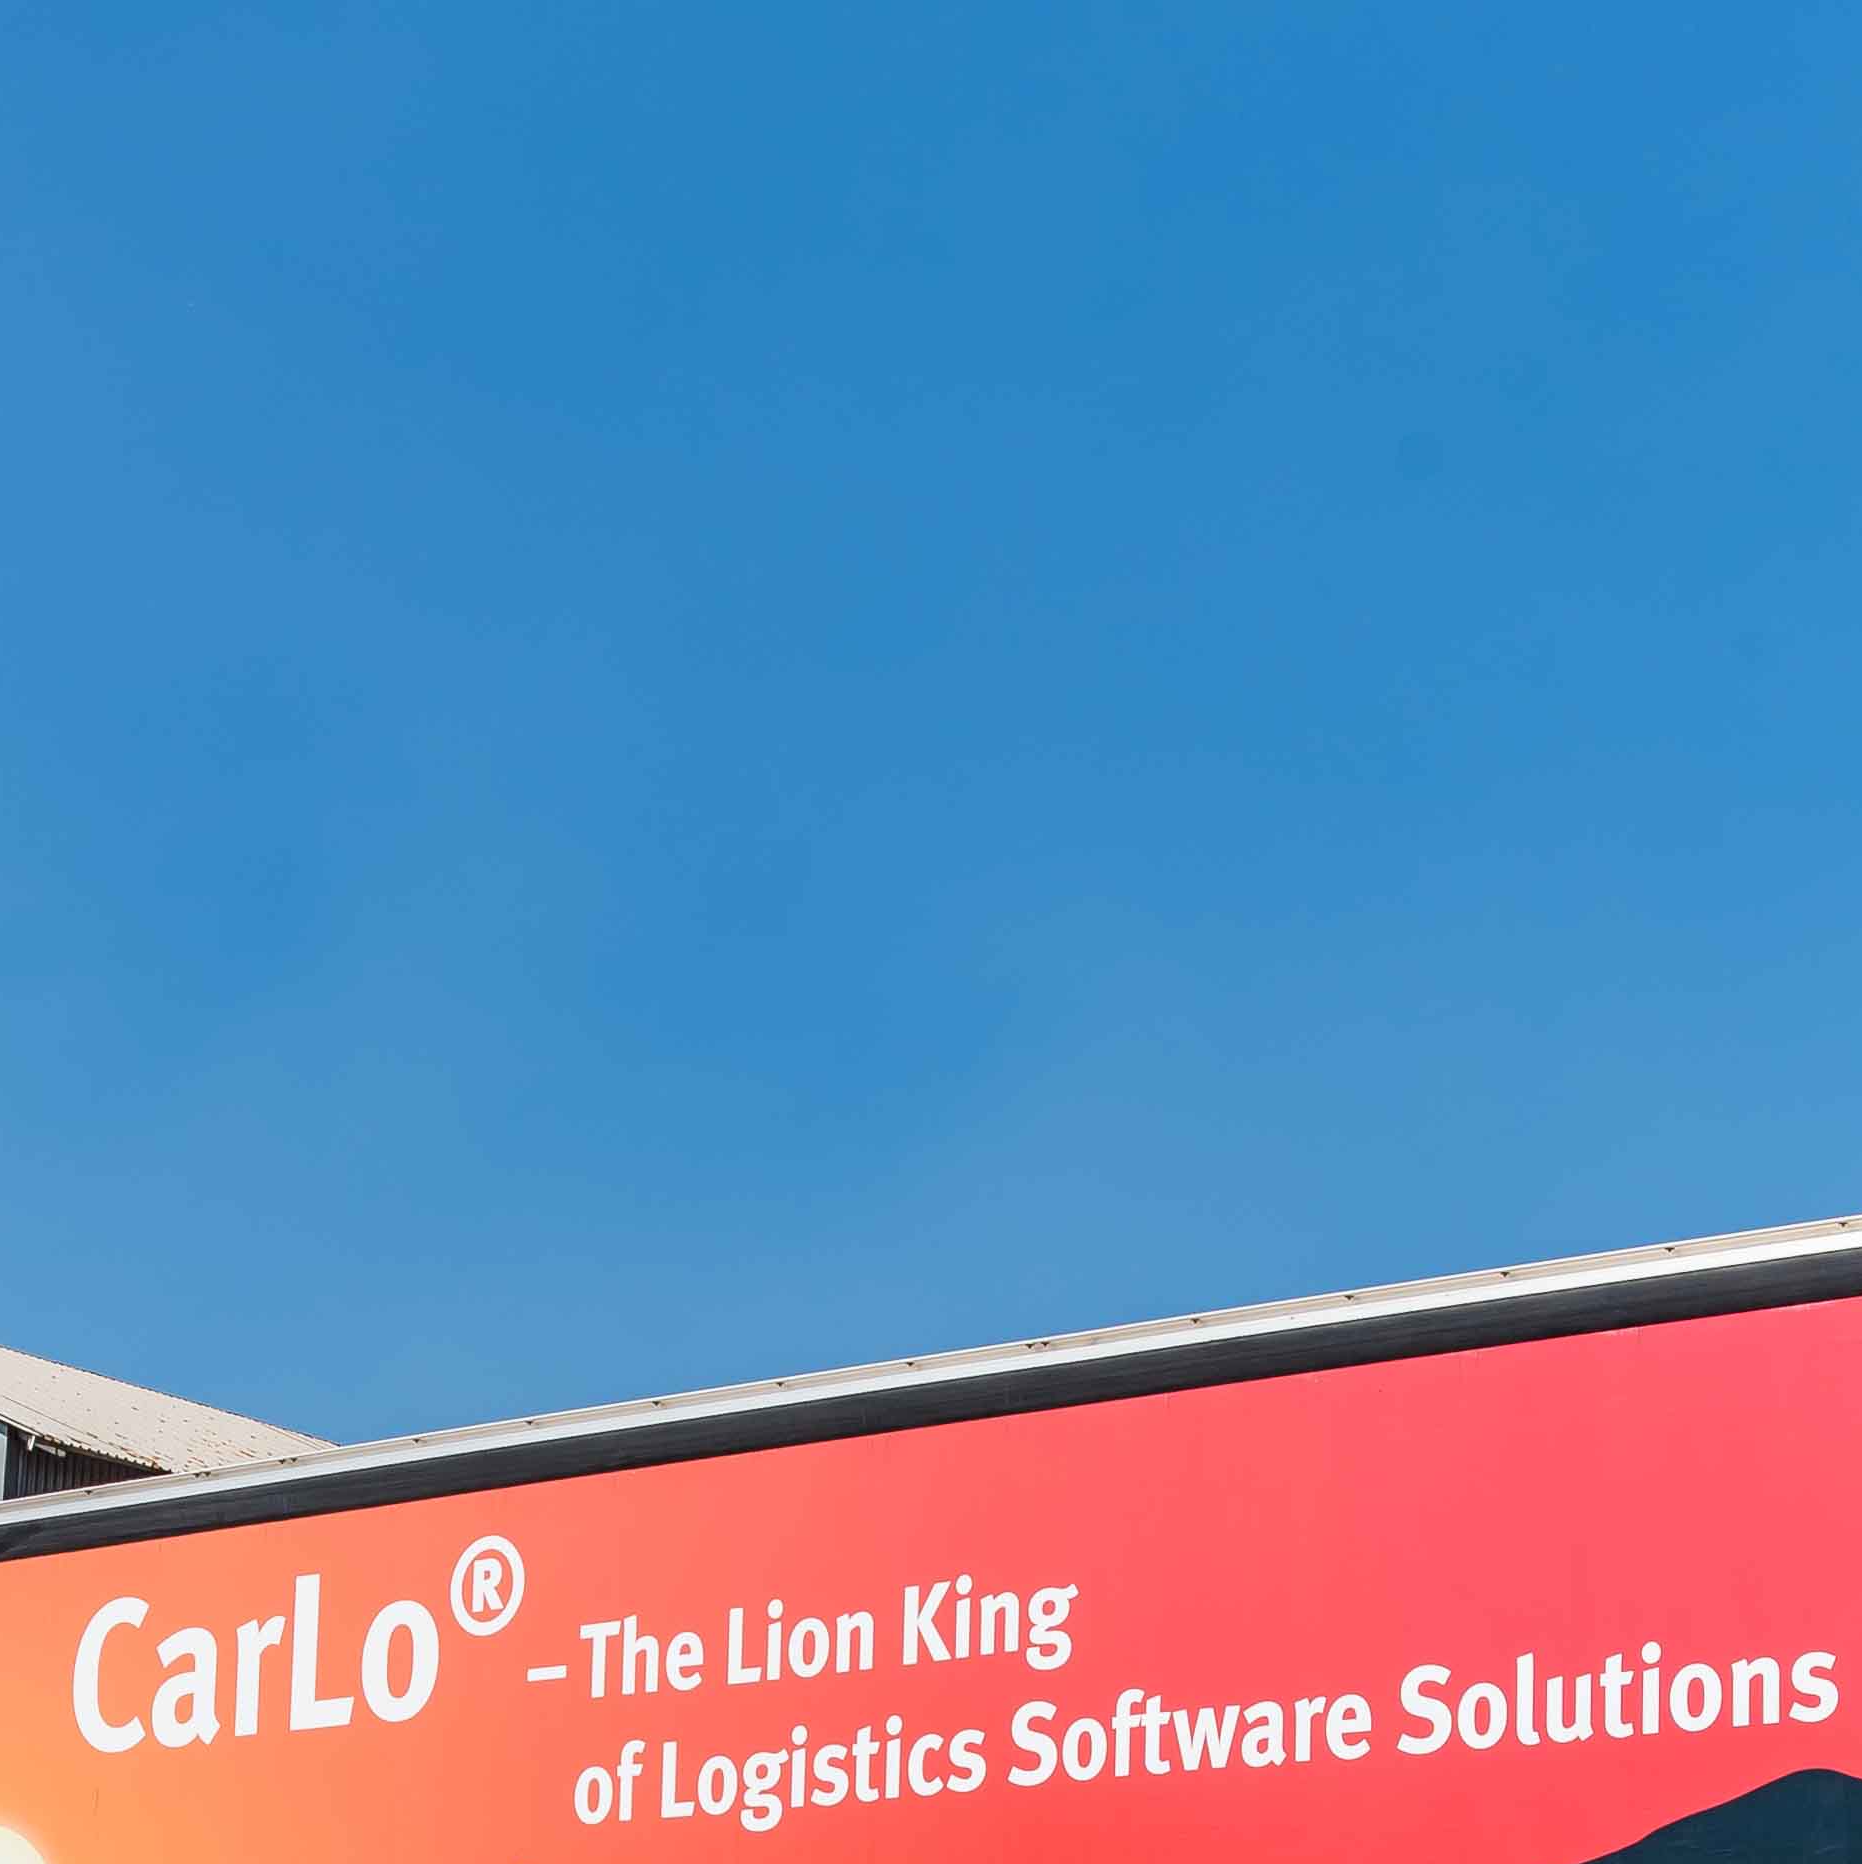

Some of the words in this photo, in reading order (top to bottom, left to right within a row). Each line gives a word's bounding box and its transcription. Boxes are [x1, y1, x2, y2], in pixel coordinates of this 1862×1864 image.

[728, 1600, 873, 1684] Lion
[903, 1575, 1078, 1670] King
[575, 1740, 645, 1824] of
[661, 1716, 986, 1831] Logistics
[1008, 1689, 1371, 1786] Software
[1398, 1642, 1838, 1754] Solutions
